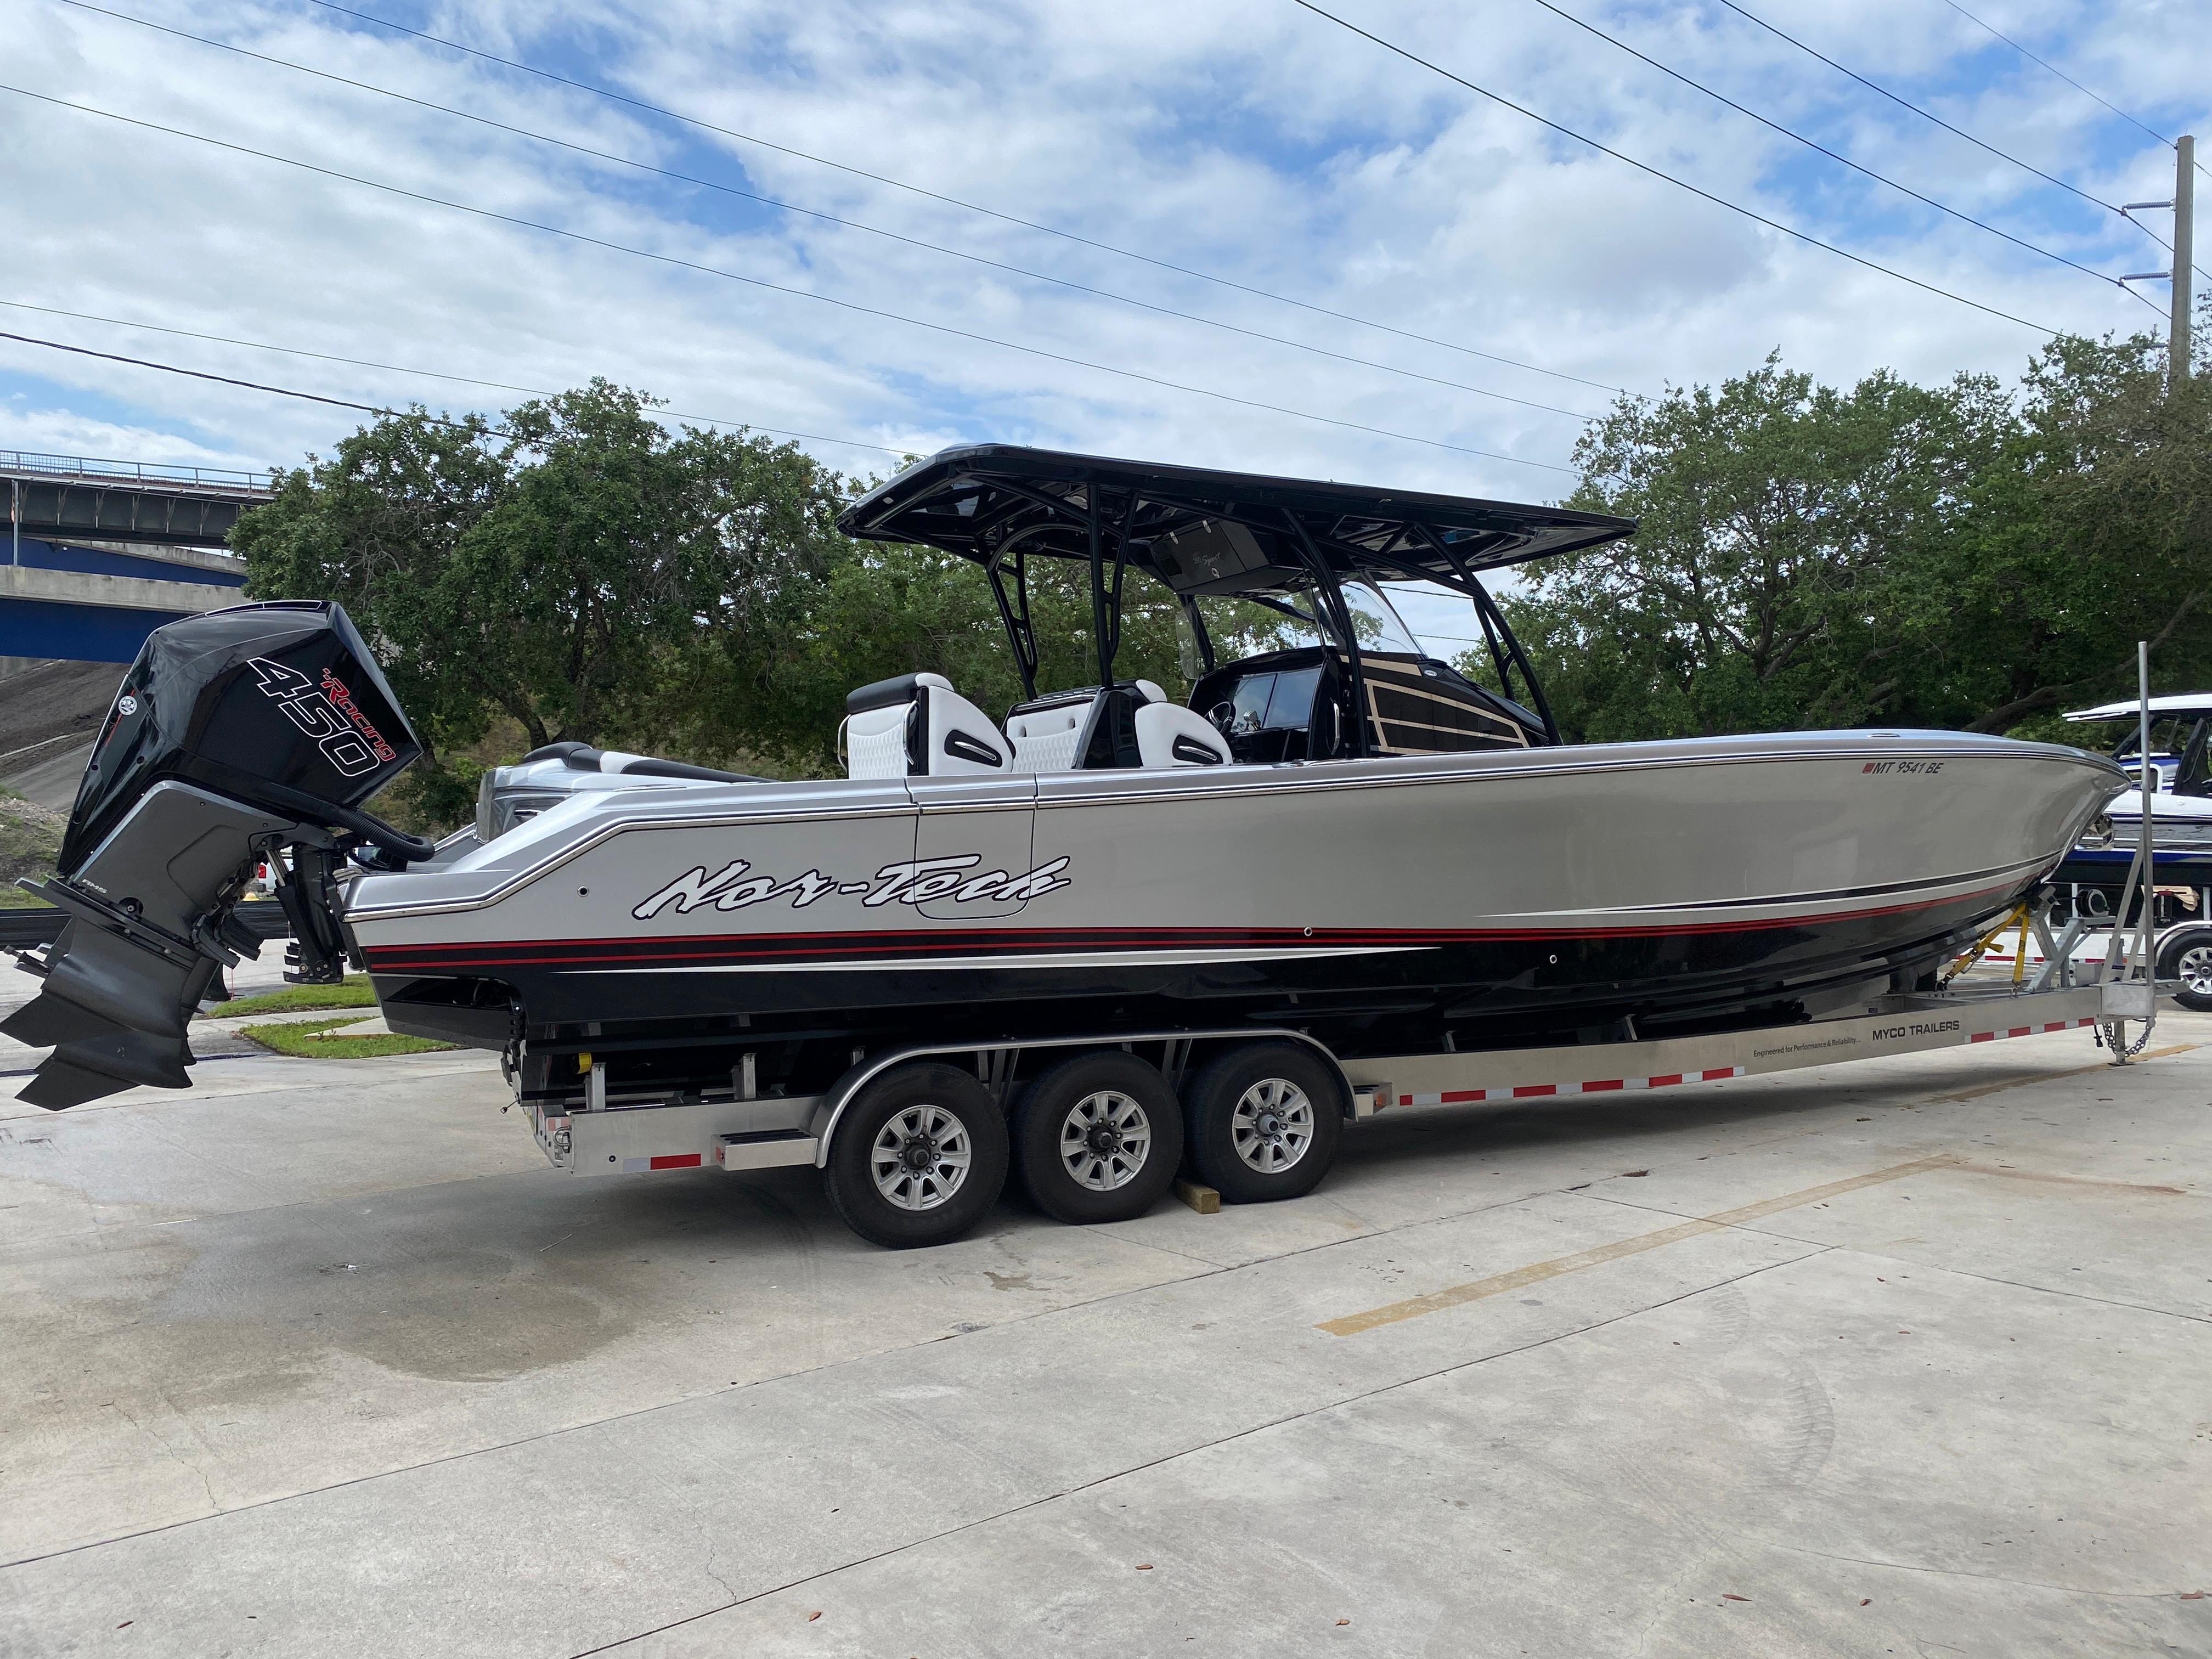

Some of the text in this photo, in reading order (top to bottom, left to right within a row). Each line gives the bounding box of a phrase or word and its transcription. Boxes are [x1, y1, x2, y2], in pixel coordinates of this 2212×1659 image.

[246, 657, 380, 777] 450
[328, 674, 396, 761] Racing
[1872, 761, 1944, 774] MT 9541 BE
[631, 853, 1073, 921] Nor-Tech
[1753, 1046, 1784, 1058] Engineered
[1793, 1041, 1826, 1052] Performance
[1872, 1020, 1960, 1041] MYCO TRAILERS
